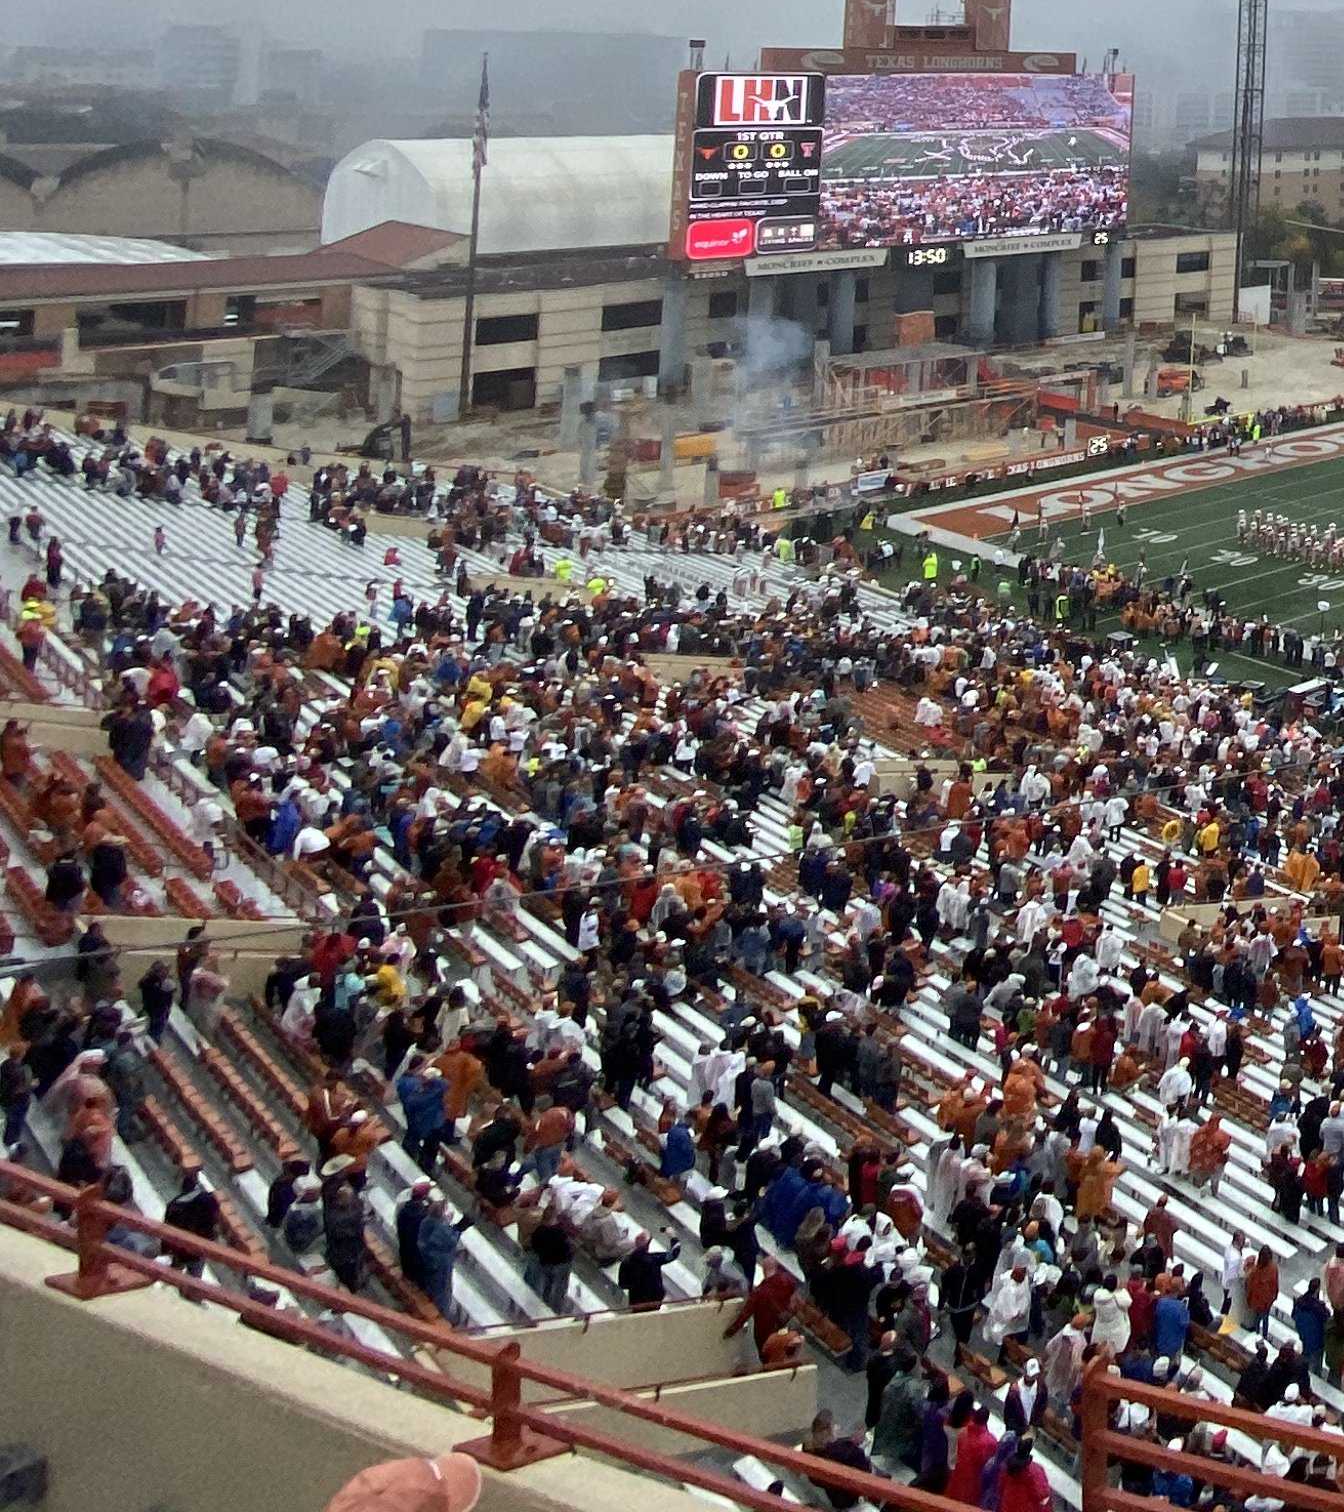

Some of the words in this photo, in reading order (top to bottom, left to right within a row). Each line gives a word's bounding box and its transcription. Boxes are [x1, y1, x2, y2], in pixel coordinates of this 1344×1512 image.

[865, 54, 915, 69] TEXAS
[923, 55, 1003, 70] LONGHORNS
[737, 131, 757, 141] 1ST
[759, 131, 785, 141] QTR
[672, 91, 689, 231] TEXAS
[695, 172, 729, 181] DOWN
[738, 171, 752, 179] TO
[753, 170, 769, 179] GO
[778, 169, 802, 178] BALL
[803, 168, 819, 176] ON
[694, 239, 730, 249] equinor
[1030, 237, 1073, 249] COMPLEX
[1094, 232, 1109, 245] 25
[826, 254, 876, 265] COMPLEX
[908, 248, 946, 266] 13:50
[1089, 437, 1108, 455] 25
[1132, 529, 1178, 544] 10
[1208, 548, 1259, 567] 20
